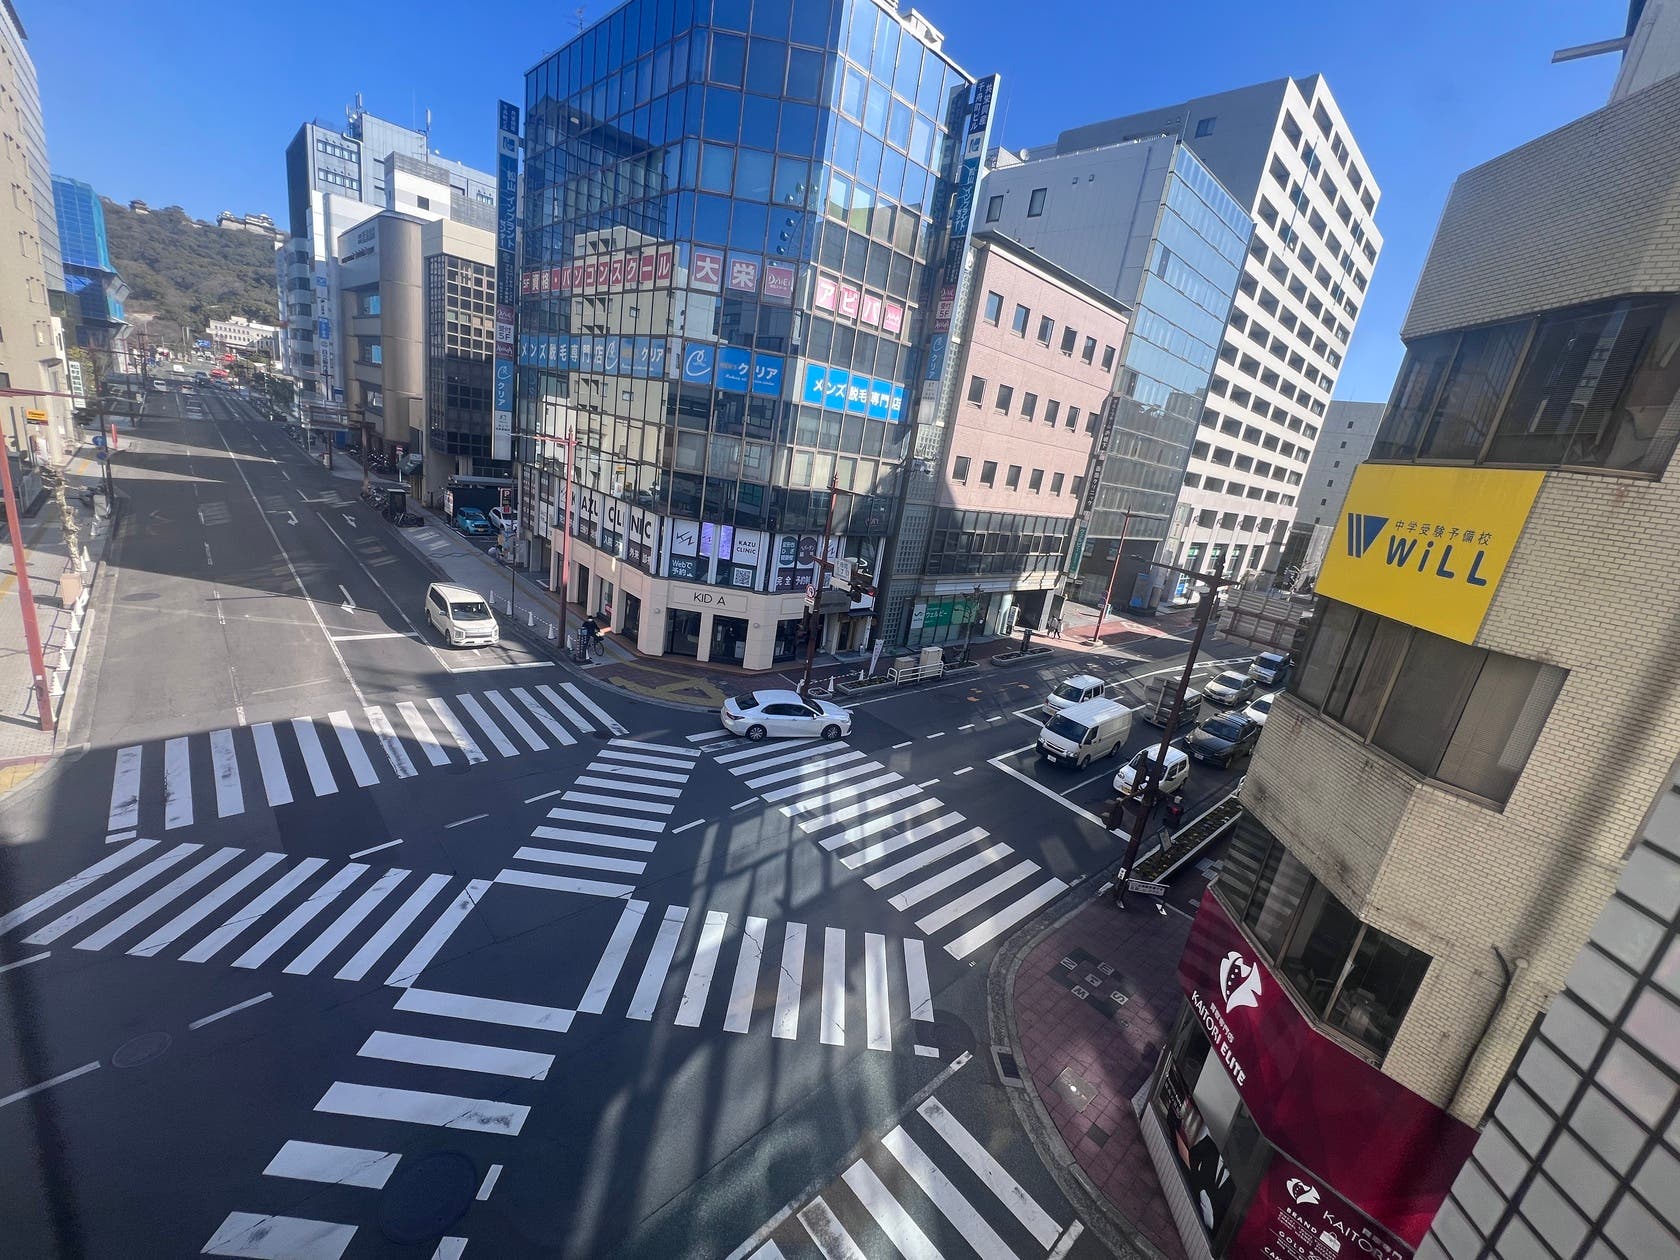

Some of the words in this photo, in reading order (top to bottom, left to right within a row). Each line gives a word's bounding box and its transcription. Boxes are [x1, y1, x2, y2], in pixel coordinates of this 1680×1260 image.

[532, 253, 672, 294] 資格・パソコンスクール
[696, 258, 757, 287] 大栄
[521, 343, 602, 365] メンズ脱毛専門店
[641, 347, 663, 362] クリア
[738, 362, 778, 380] クリア
[929, 354, 937, 379] クリア
[497, 382, 506, 406] クリア
[813, 377, 902, 412] メンズ脱毛専門店
[738, 540, 757, 548] KAZU
[1395, 519, 1493, 546] 中学受験予備校
[736, 547, 757, 555] CLINIC
[1386, 534, 1487, 587] WiLL
[672, 559, 693, 570] Webで
[694, 592, 713, 604] KID
[717, 596, 726, 606] A
[1191, 990, 1221, 1044] KAITORI
[1220, 1041, 1246, 1087] ELITE
[1286, 1207, 1318, 1234] BRAND
[1278, 1230, 1305, 1254] GOLD
